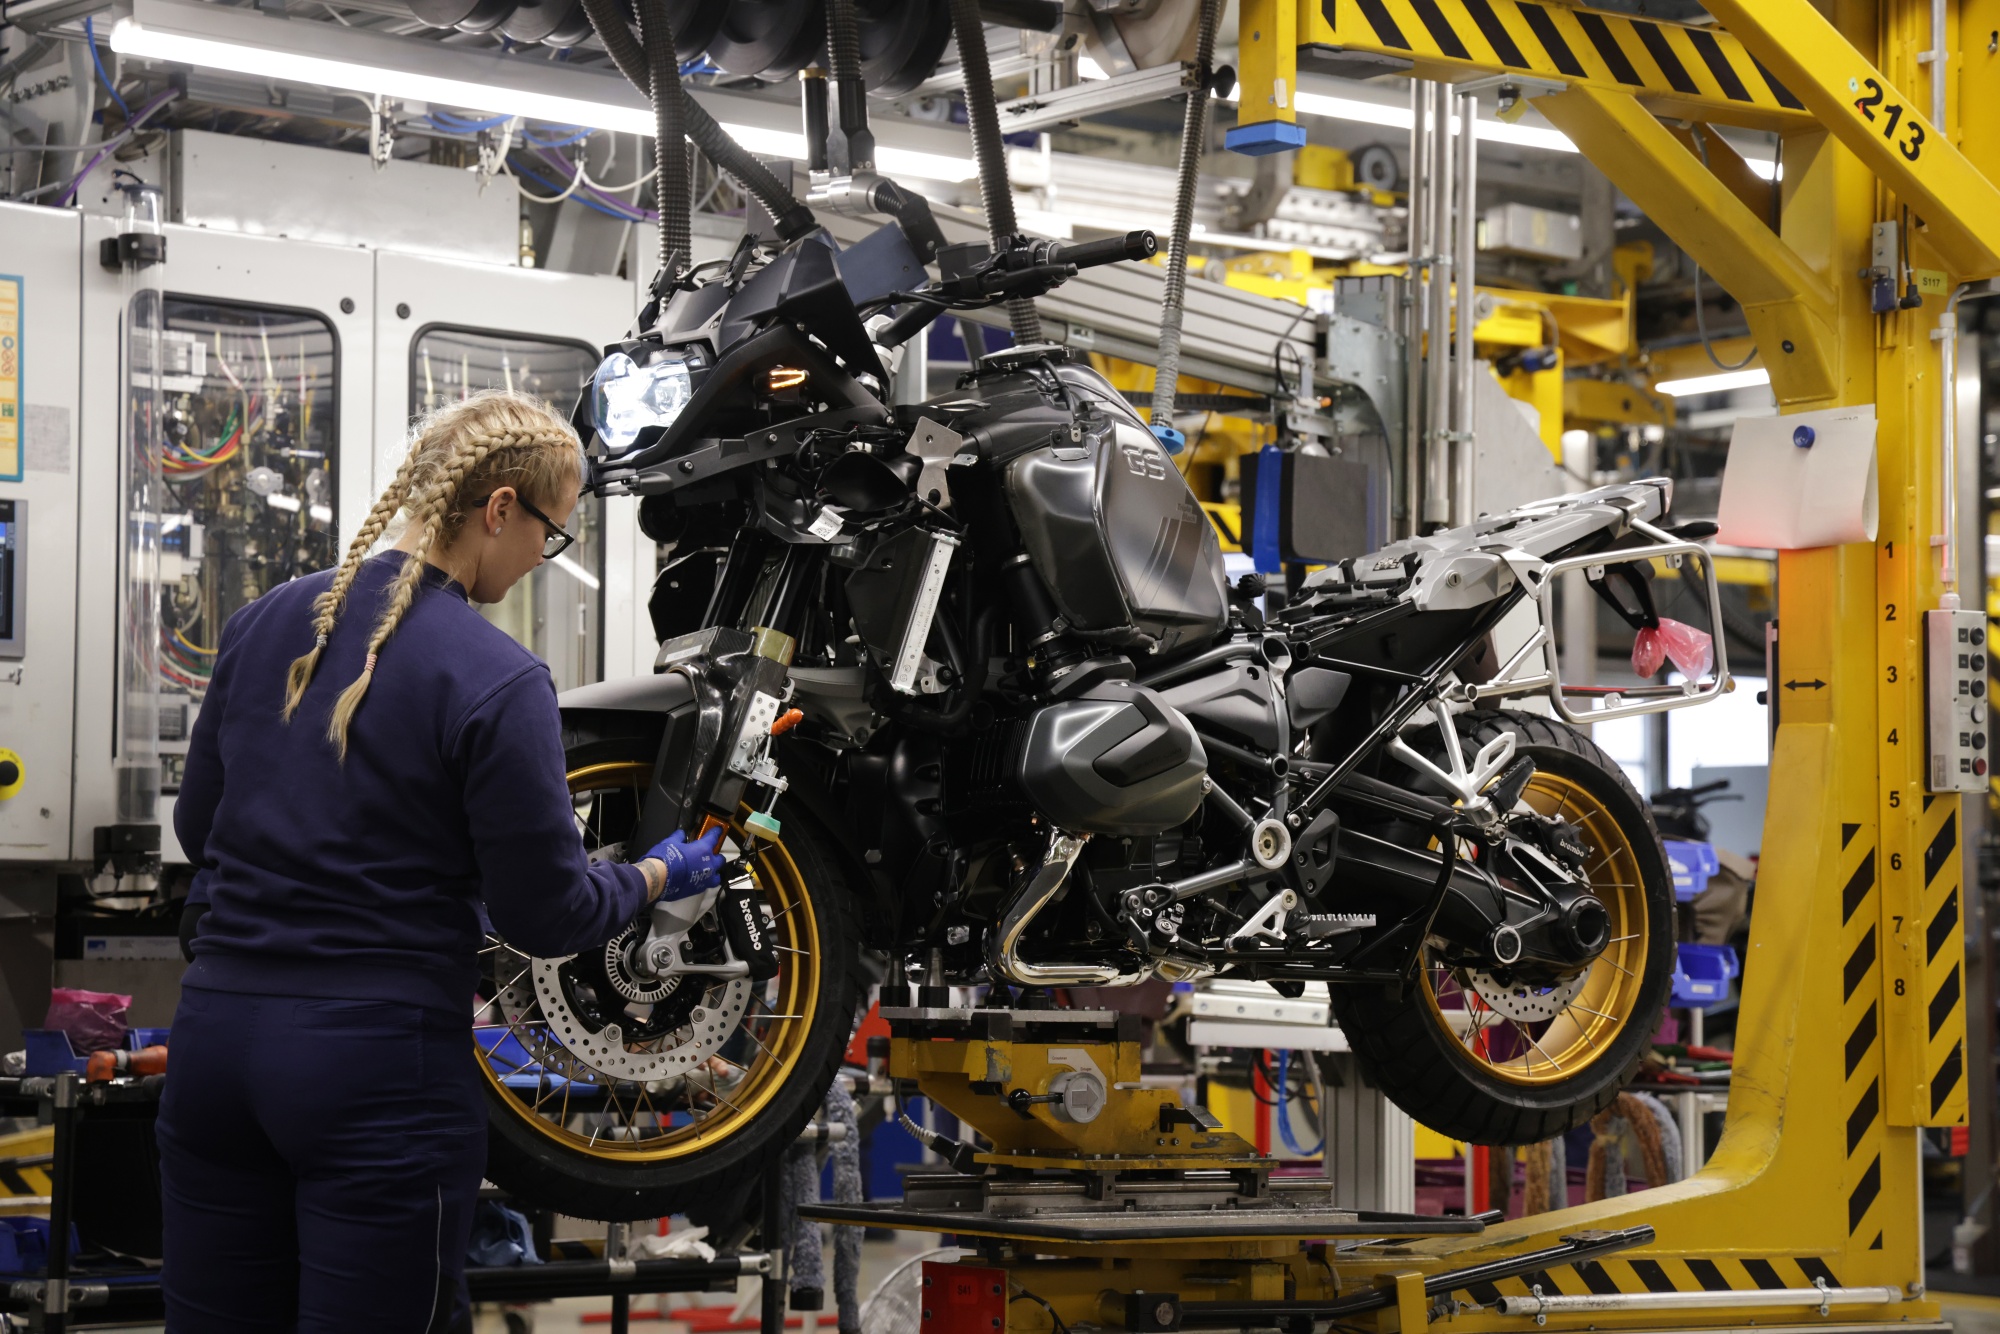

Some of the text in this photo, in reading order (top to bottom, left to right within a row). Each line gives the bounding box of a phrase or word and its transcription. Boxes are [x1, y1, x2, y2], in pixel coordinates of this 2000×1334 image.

[1854, 78, 1925, 161] 213
[1923, 277, 1940, 287] S117
[1122, 444, 1166, 480] GS
[1884, 541, 1894, 559] 1
[1885, 603, 1897, 622] 2
[1887, 665, 1898, 684] 3
[1887, 728, 1899, 746] 4
[1889, 790, 1901, 809] 5
[1560, 838, 1585, 857] brembo
[1890, 852, 1902, 871] 6
[739, 897, 762, 951] brembo
[1892, 915, 1904, 934] 7
[1894, 978, 1906, 997] 8
